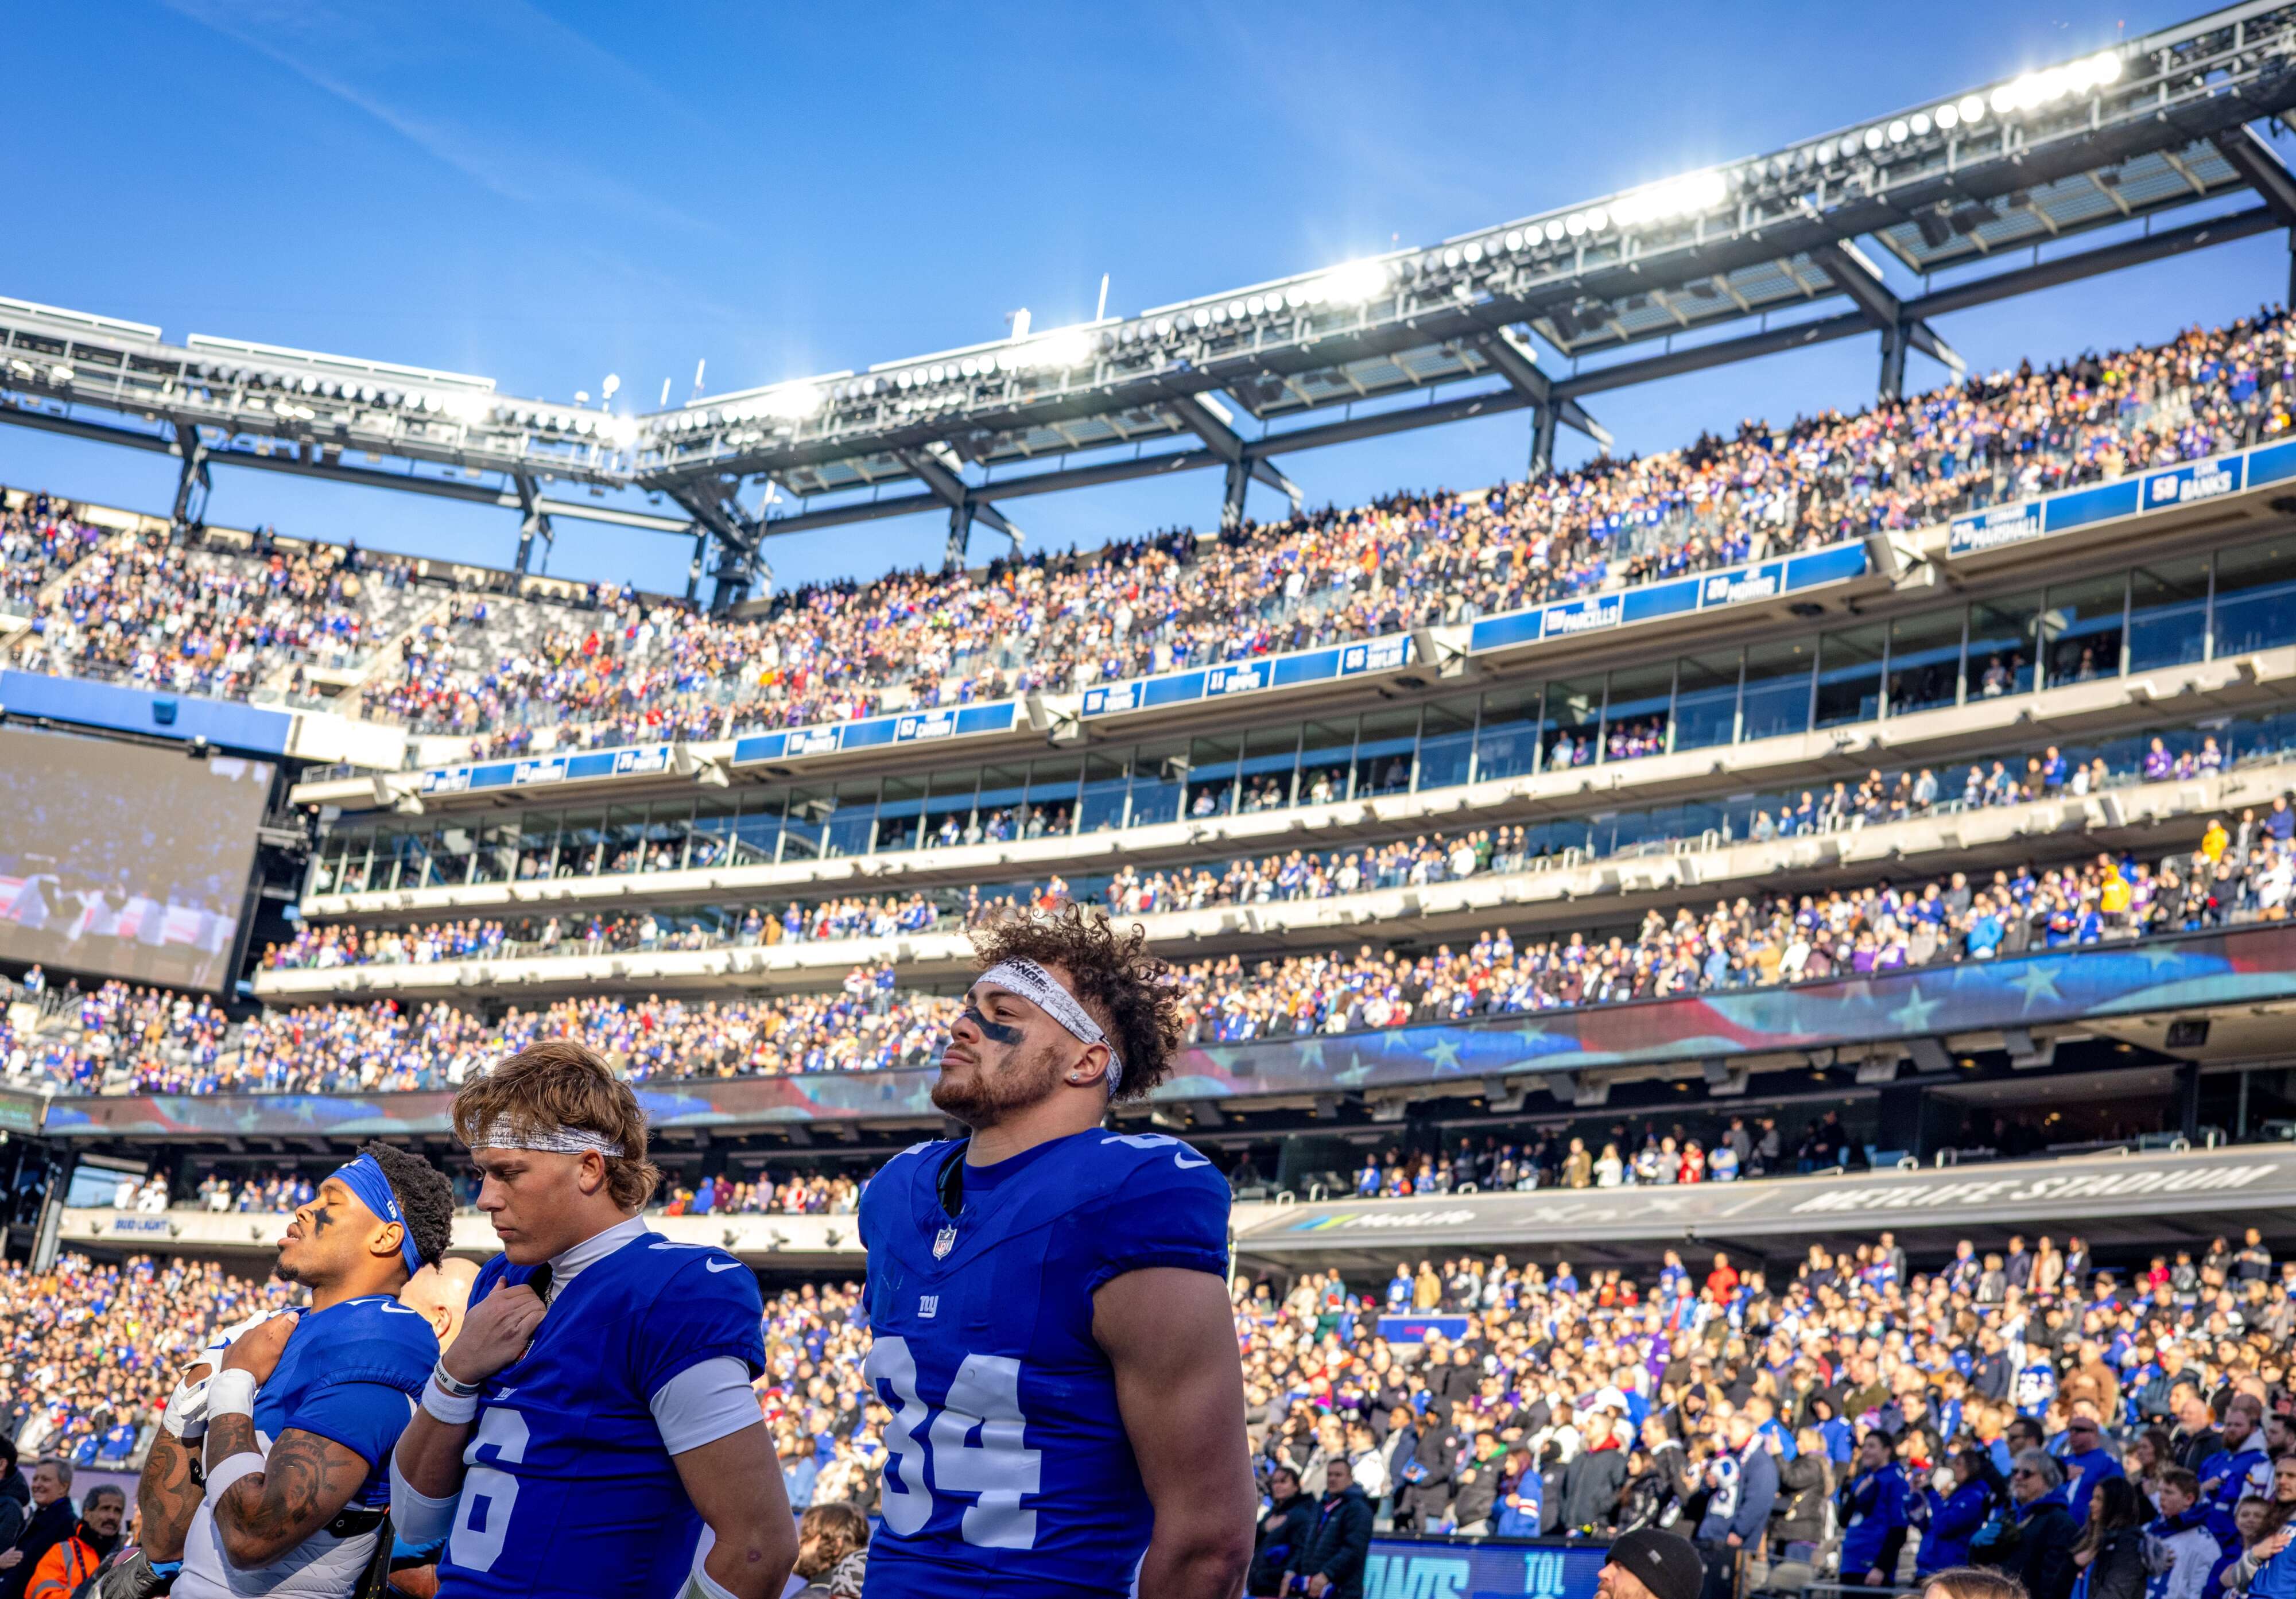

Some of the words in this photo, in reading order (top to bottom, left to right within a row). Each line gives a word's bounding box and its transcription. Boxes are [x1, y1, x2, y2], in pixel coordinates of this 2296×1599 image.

[2179, 470, 2232, 502] BANKS
[1562, 605, 1618, 633] PARCELLS
[1791, 1179, 2022, 1214] METLIFE
[2010, 1163, 2280, 1201] STADIUM
[115, 1218, 135, 1230] BUD
[864, 1336, 1042, 1550] 84
[449, 1407, 531, 1572] 6
[1363, 1555, 1470, 1599] ANTS
